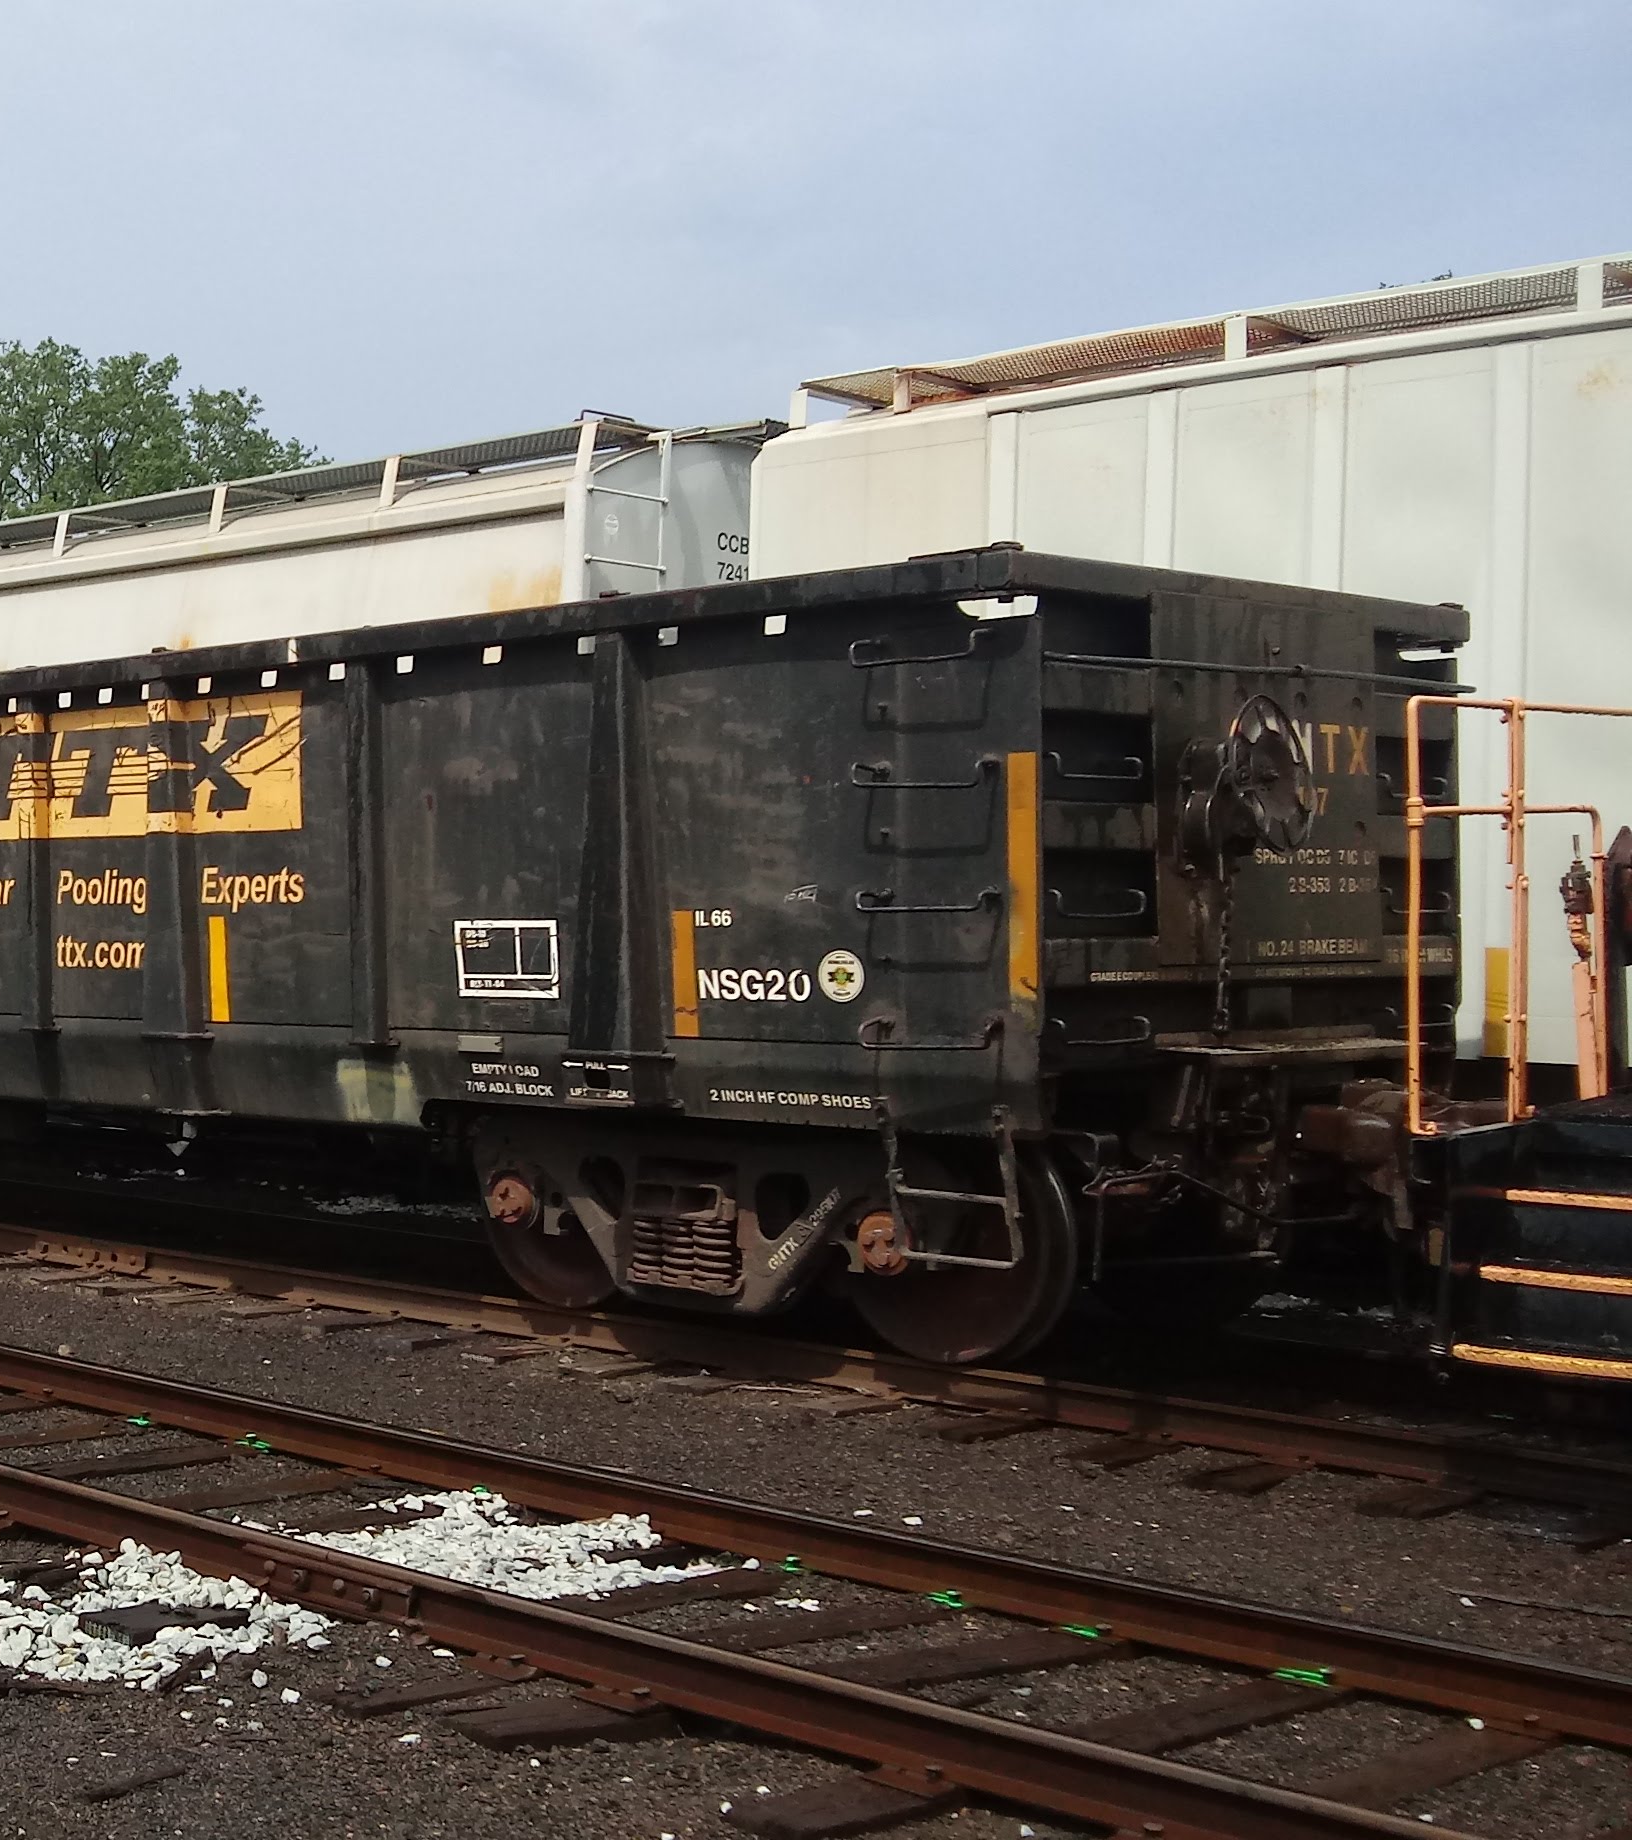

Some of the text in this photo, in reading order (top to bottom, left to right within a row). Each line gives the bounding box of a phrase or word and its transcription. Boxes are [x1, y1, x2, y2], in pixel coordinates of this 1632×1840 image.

[57, 868, 147, 914] Pooling
[201, 865, 304, 913] Experts
[695, 910, 732, 927] IL 66
[698, 968, 812, 1002] NSG20
[471, 1062, 506, 1076] EMPTY
[585, 1061, 606, 1070] PULL
[465, 1080, 487, 1093] 7/16
[515, 1083, 555, 1097] BLOCK
[709, 1089, 872, 1109] 2 INCH HF COMP SHOES
